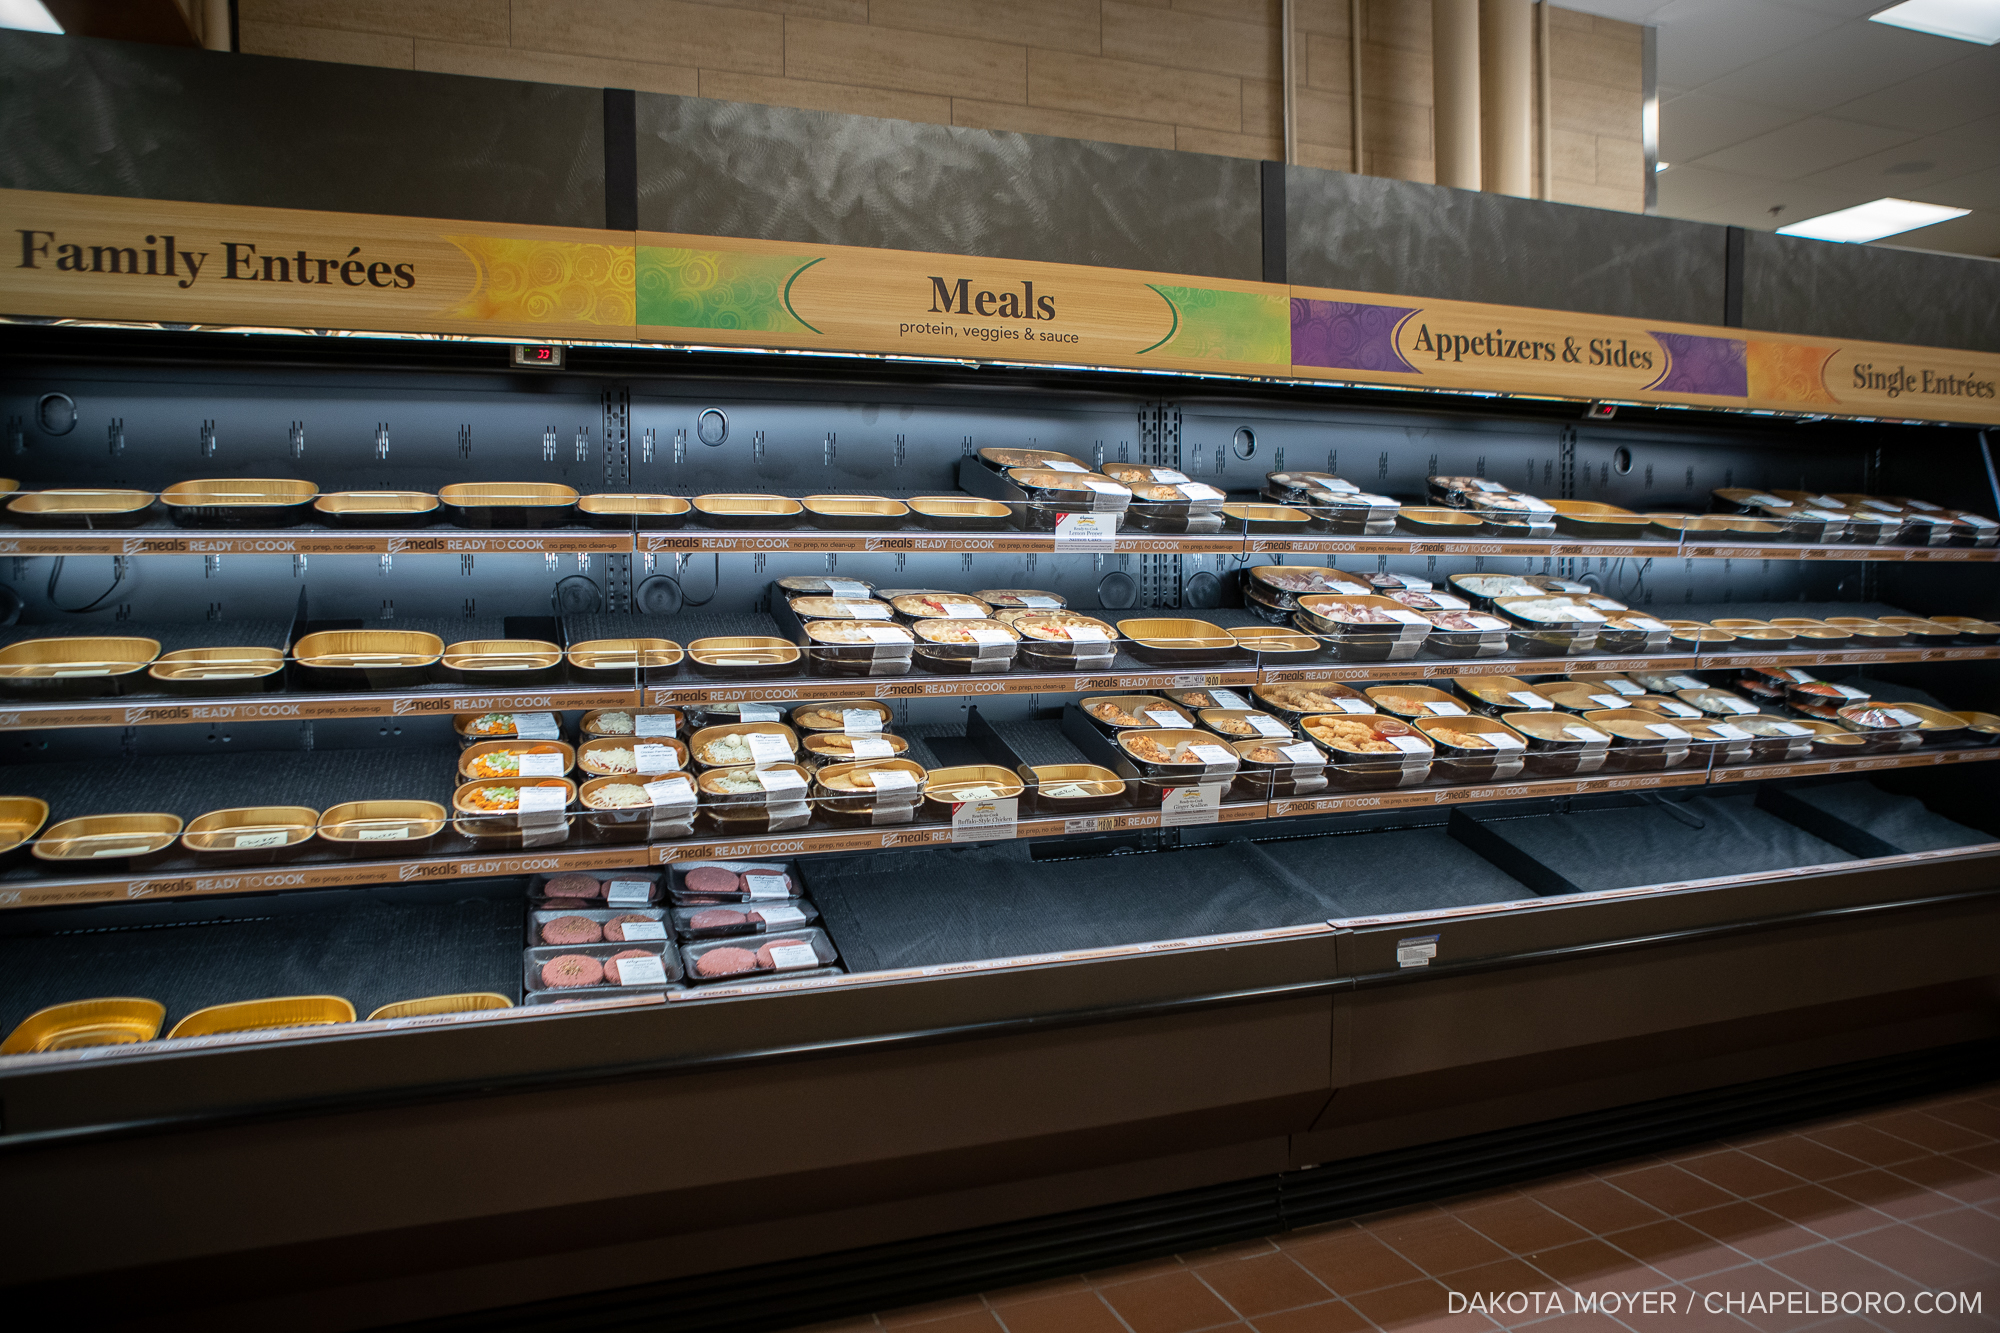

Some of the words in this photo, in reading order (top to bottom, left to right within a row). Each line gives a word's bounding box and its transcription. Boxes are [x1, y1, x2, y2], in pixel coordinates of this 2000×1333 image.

[14, 228, 209, 289] Family
[221, 241, 416, 290] Entrées
[927, 276, 1056, 320] Meals
[900, 322, 957, 337] protein,
[963, 326, 1019, 341] veggies
[1024, 328, 1035, 341] &
[1040, 331, 1079, 344] sauce
[1413, 324, 1556, 362] Appetizers
[1562, 336, 1582, 364] &
[1588, 338, 1653, 370] Sides
[1853, 363, 1917, 398] Single
[1921, 370, 1995, 398] Entrées
[190, 541, 234, 552] READY
[237, 541, 253, 551] TO
[256, 540, 296, 551] COOK
[448, 540, 487, 550] READY
[490, 540, 505, 550] TO
[508, 540, 544, 550] COOK
[702, 539, 738, 548] READY
[740, 539, 754, 548] TO
[756, 539, 789, 548] COOK
[915, 540, 948, 549] READY
[951, 540, 963, 549] TO
[964, 540, 994, 549] COOK
[1115, 541, 1137, 550] EADY
[1140, 541, 1150, 550] TO
[1153, 541, 1179, 550] COOK
[1293, 543, 1319, 551] READY
[1321, 543, 1331, 551] TO
[1332, 543, 1356, 551] COOK
[1445, 544, 1469, 553] READY
[1471, 545, 1480, 553] TO
[1481, 545, 1503, 553] COOK
[1306, 671, 1332, 680] READY
[1334, 671, 1344, 679] TO
[1345, 670, 1369, 678] COOK
[1459, 666, 1483, 674] READY
[1485, 666, 1494, 674] TO
[1495, 665, 1516, 673] COOK
[1120, 678, 1150, 687] READY
[1152, 678, 1163, 686] TO
[926, 684, 958, 694] READY
[961, 684, 974, 693] TO
[975, 683, 1005, 692] COOK
[710, 690, 747, 701] READY
[750, 690, 763, 699] TO
[765, 689, 798, 699] COOK
[454, 699, 494, 710] READY
[498, 698, 512, 709] TO
[515, 697, 551, 707] COOK
[192, 706, 237, 718] READY
[239, 706, 257, 716] TO
[259, 705, 300, 716] COOK
[1471, 789, 1495, 798] READY
[1506, 787, 1528, 795] COOK
[1317, 800, 1343, 810] READY
[1345, 799, 1355, 808] TO
[1357, 798, 1381, 807] COOK
[1128, 816, 1159, 826] READY
[933, 832, 952, 841] REA
[715, 845, 752, 856] READY
[754, 844, 768, 854] TO
[771, 841, 804, 852] COOK
[460, 862, 501, 874] READY
[505, 861, 520, 872] TO
[522, 859, 559, 870] COOK
[196, 878, 241, 891] READY
[244, 876, 262, 888] TO
[264, 874, 305, 886] COOK
